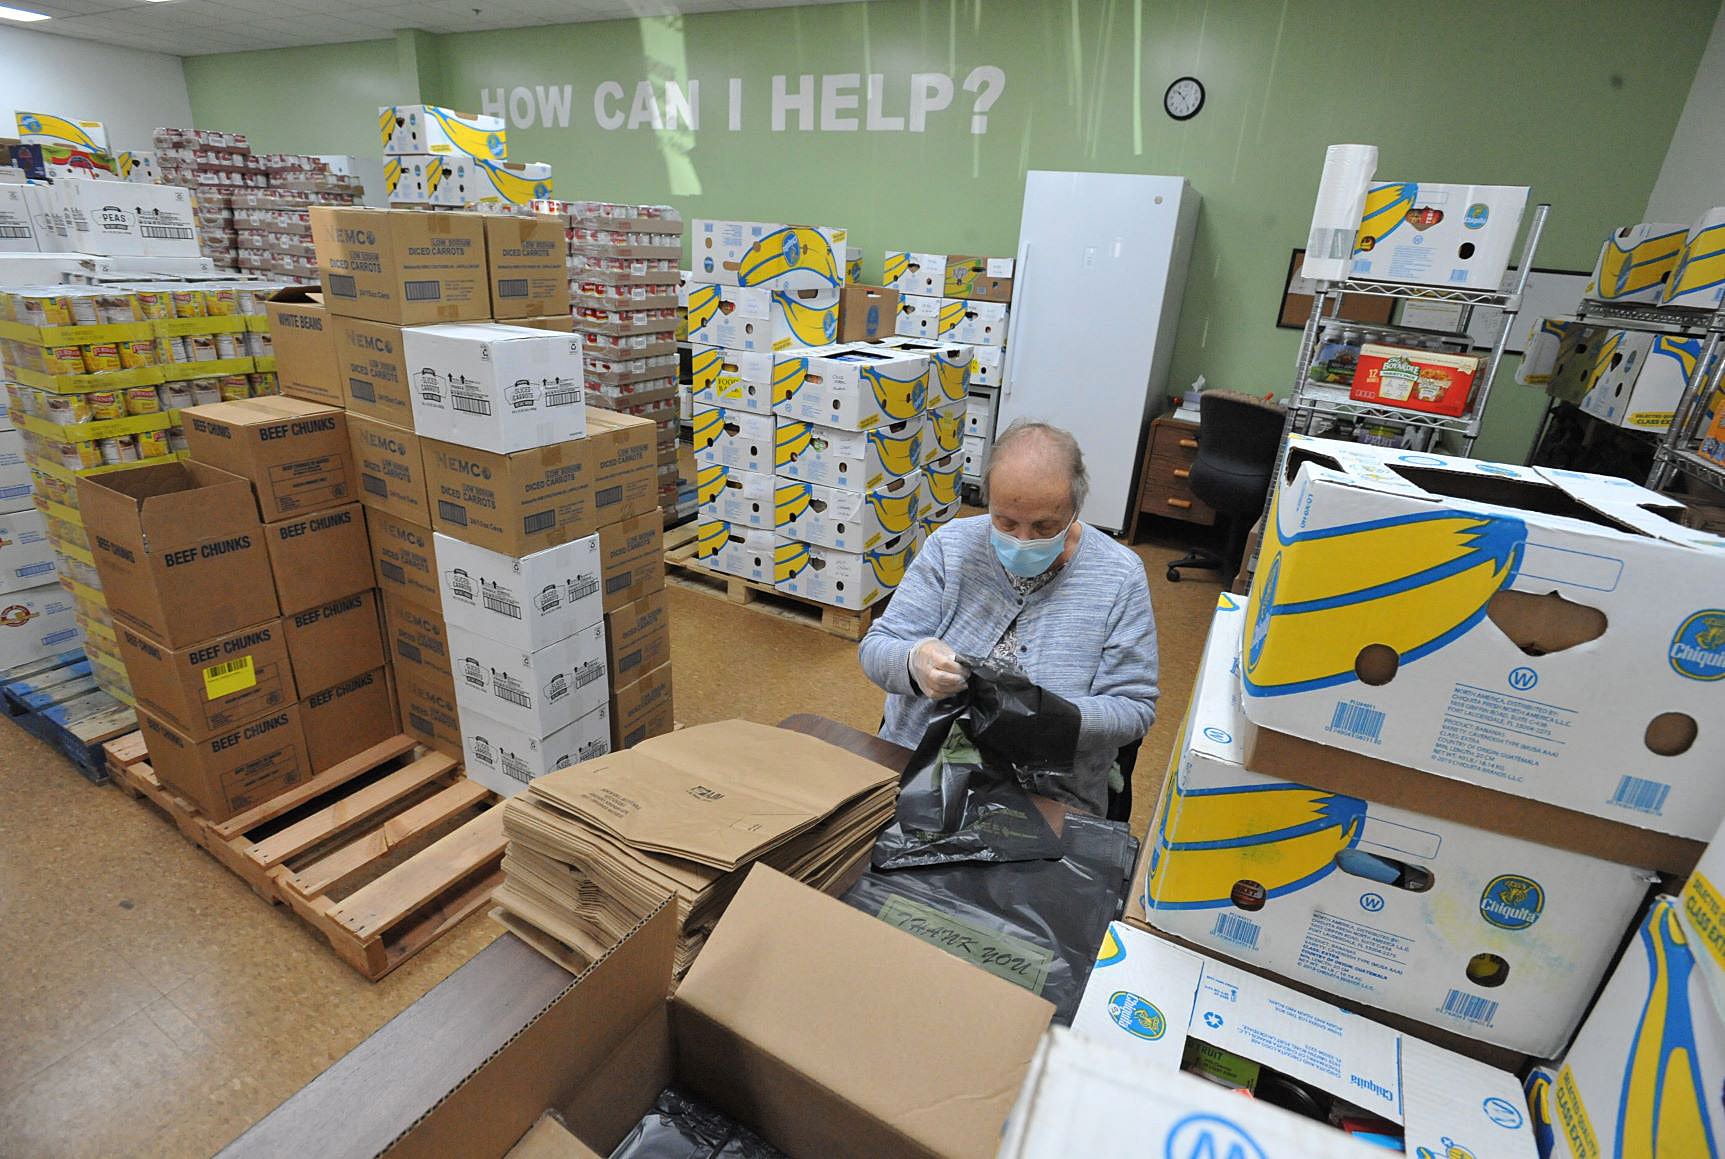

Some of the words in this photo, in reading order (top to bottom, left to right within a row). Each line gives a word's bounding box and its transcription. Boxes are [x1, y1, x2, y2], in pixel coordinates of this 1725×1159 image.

[481, 84, 573, 129] HOW
[594, 80, 699, 131] CAN
[728, 78, 742, 131] I
[771, 66, 1007, 134] HELP?
[102, 213, 127, 223] PEAS
[408, 247, 431, 256] DICED
[431, 247, 465, 256] CARROTS
[503, 248, 521, 256] DICED
[350, 260, 383, 273] CARROTS
[278, 313, 298, 327] WHITE
[299, 315, 323, 331] BEANS
[1368, 368, 1379, 378] 12
[192, 419, 207, 432] BEEF
[259, 424, 289, 441] BEEF
[291, 417, 336, 436] CHUNKS
[525, 480, 545, 493] DICED
[545, 472, 576, 487] CARROTS
[440, 485, 462, 499] DICED
[462, 493, 497, 509] CARROTS
[280, 521, 307, 540] BEEF
[309, 511, 351, 532] CHUNKS
[164, 547, 198, 568] BEEF
[201, 535, 251, 559] CHUNKS
[294, 609, 322, 628] BEEF
[323, 596, 363, 619] CHUNKS
[189, 645, 221, 665] BEEF
[223, 629, 272, 654] CHUNKS
[309, 689, 335, 709] BEEF
[335, 673, 374, 698] CHUNKS
[1525, 711, 1553, 723] AMERICA
[211, 732, 241, 753] BEEF
[243, 713, 289, 740] CHUNKS
[1480, 898, 1537, 923] Chiquita
[1686, 896, 1709, 935] CLASS
[896, 911, 979, 953] THANK
[982, 945, 1031, 976] YOU
[1350, 1074, 1394, 1102] Chiquita
[1556, 1086, 1572, 1128] CLASS
